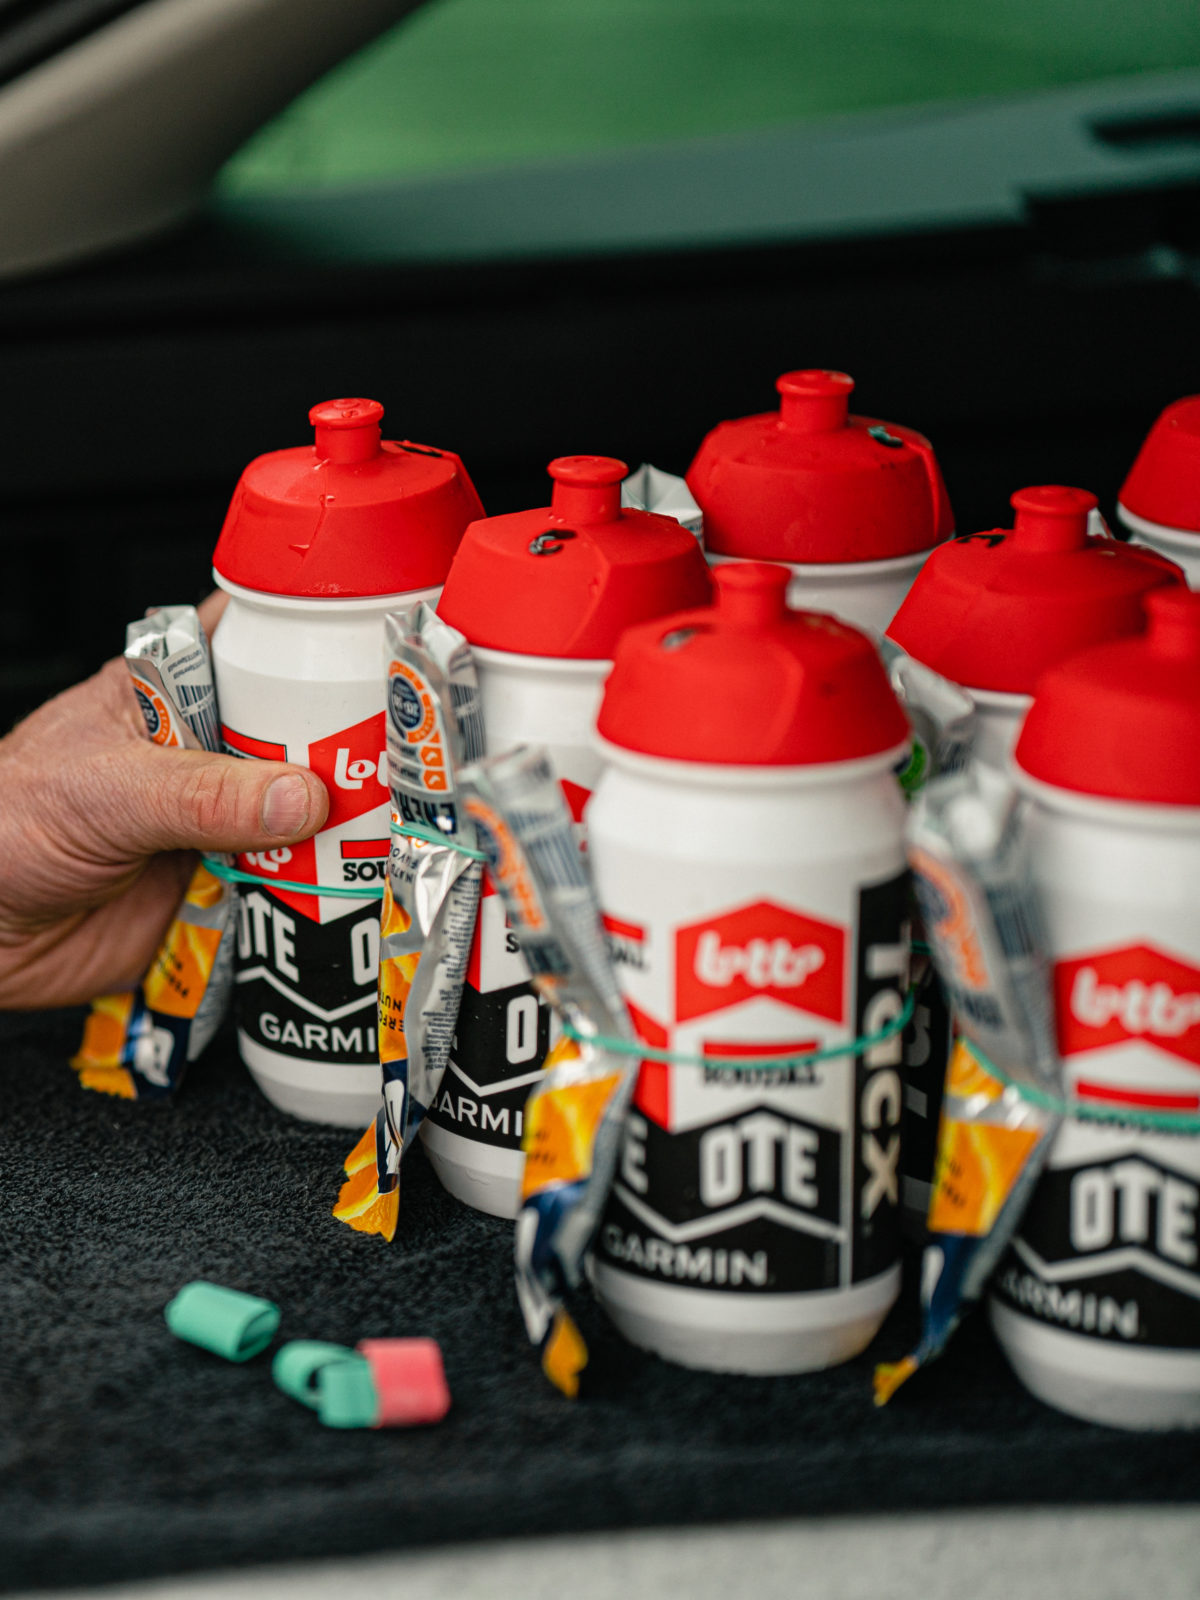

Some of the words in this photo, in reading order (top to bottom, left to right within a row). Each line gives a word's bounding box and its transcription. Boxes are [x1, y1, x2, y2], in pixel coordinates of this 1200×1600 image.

[259, 1012, 376, 1053] GARMI
[701, 1111, 820, 1209] OTE
[1069, 1159, 1200, 1267] OTE
[604, 1223, 768, 1287] GARMIN
